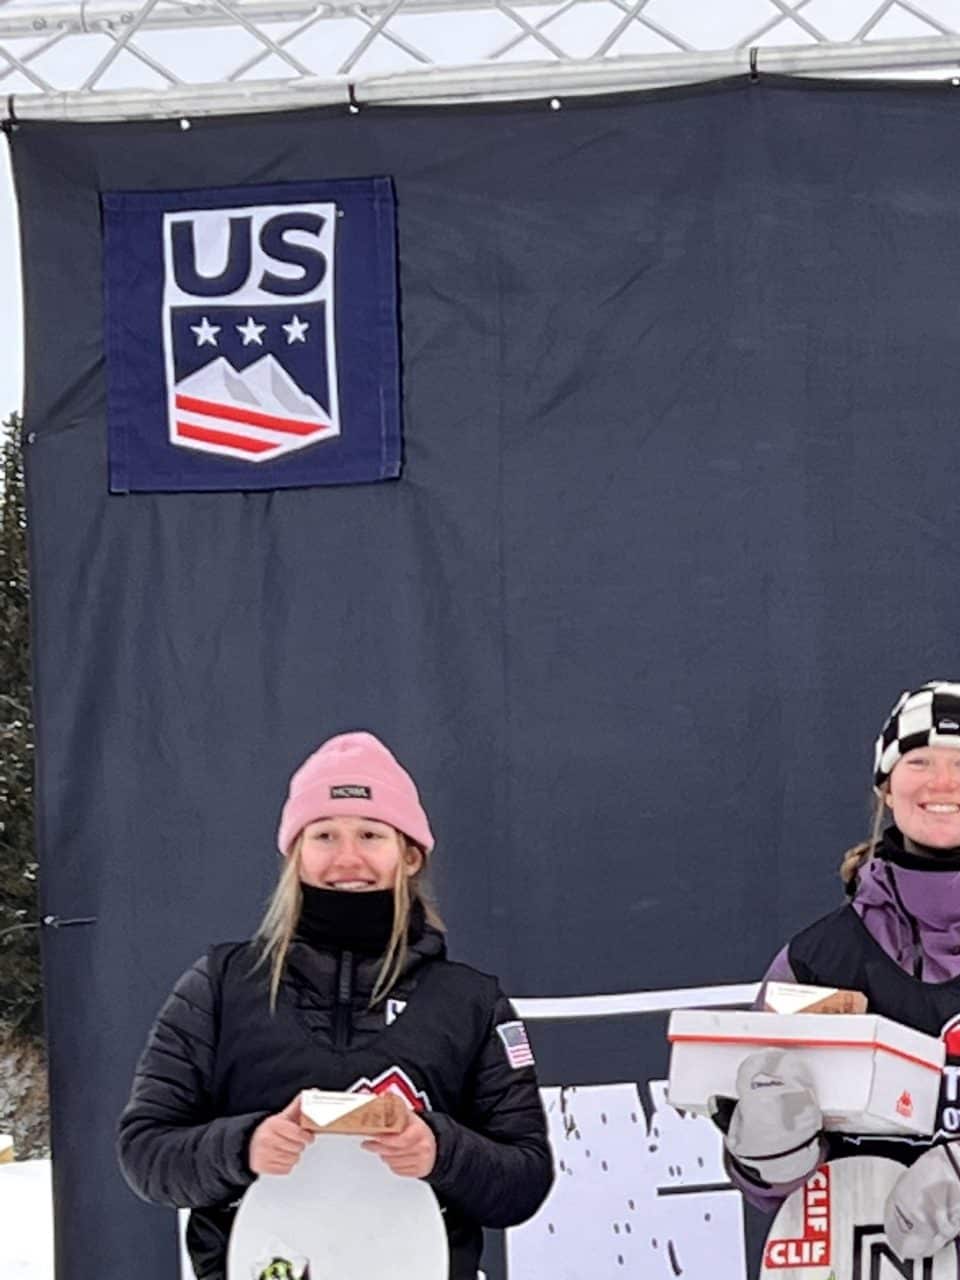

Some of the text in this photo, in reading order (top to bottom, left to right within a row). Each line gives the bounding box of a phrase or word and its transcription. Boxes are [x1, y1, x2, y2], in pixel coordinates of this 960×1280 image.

[170, 211, 327, 298] US
[807, 1170, 828, 1232] CLIF
[769, 1240, 827, 1265] CLIF
